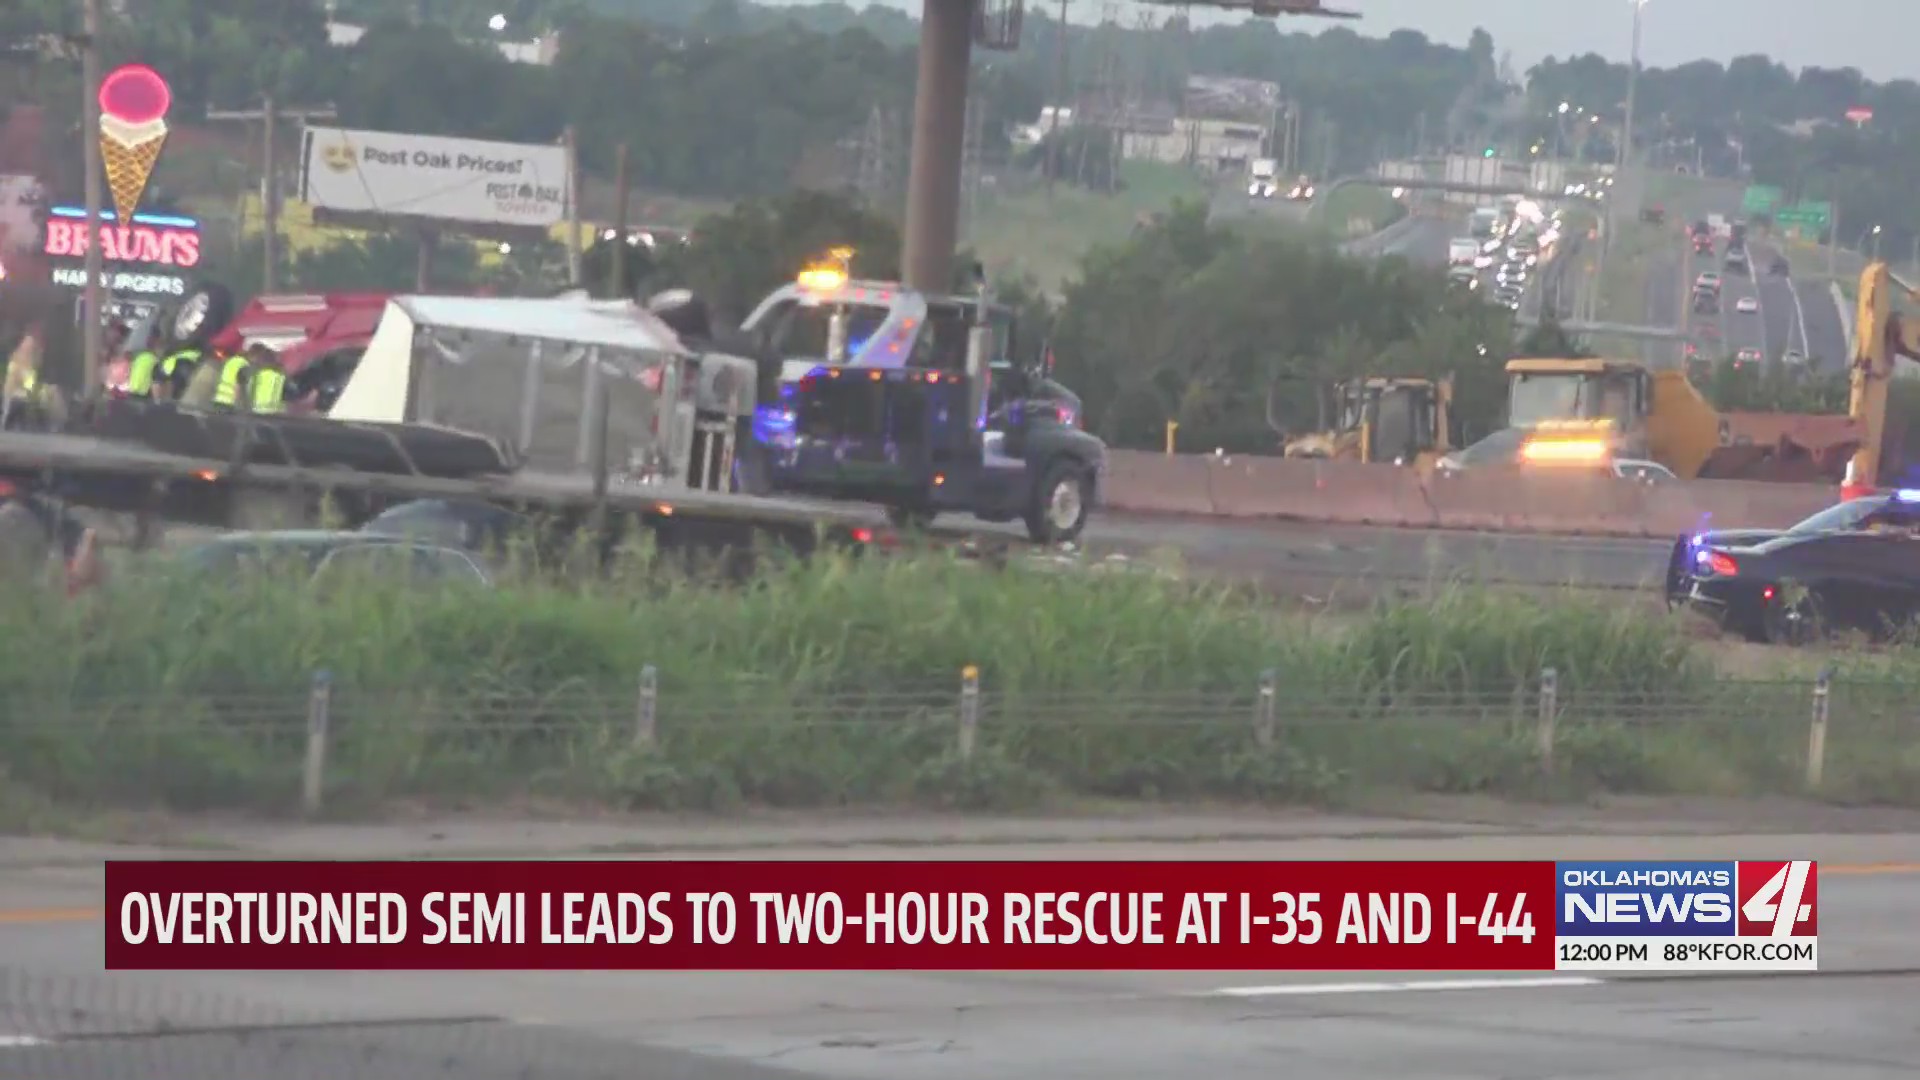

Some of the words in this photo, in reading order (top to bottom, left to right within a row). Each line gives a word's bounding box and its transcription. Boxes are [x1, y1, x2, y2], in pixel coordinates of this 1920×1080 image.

[364, 146, 407, 165] Post
[413, 150, 450, 168] Oak
[457, 153, 523, 174] Prices!
[486, 183, 517, 199] POST
